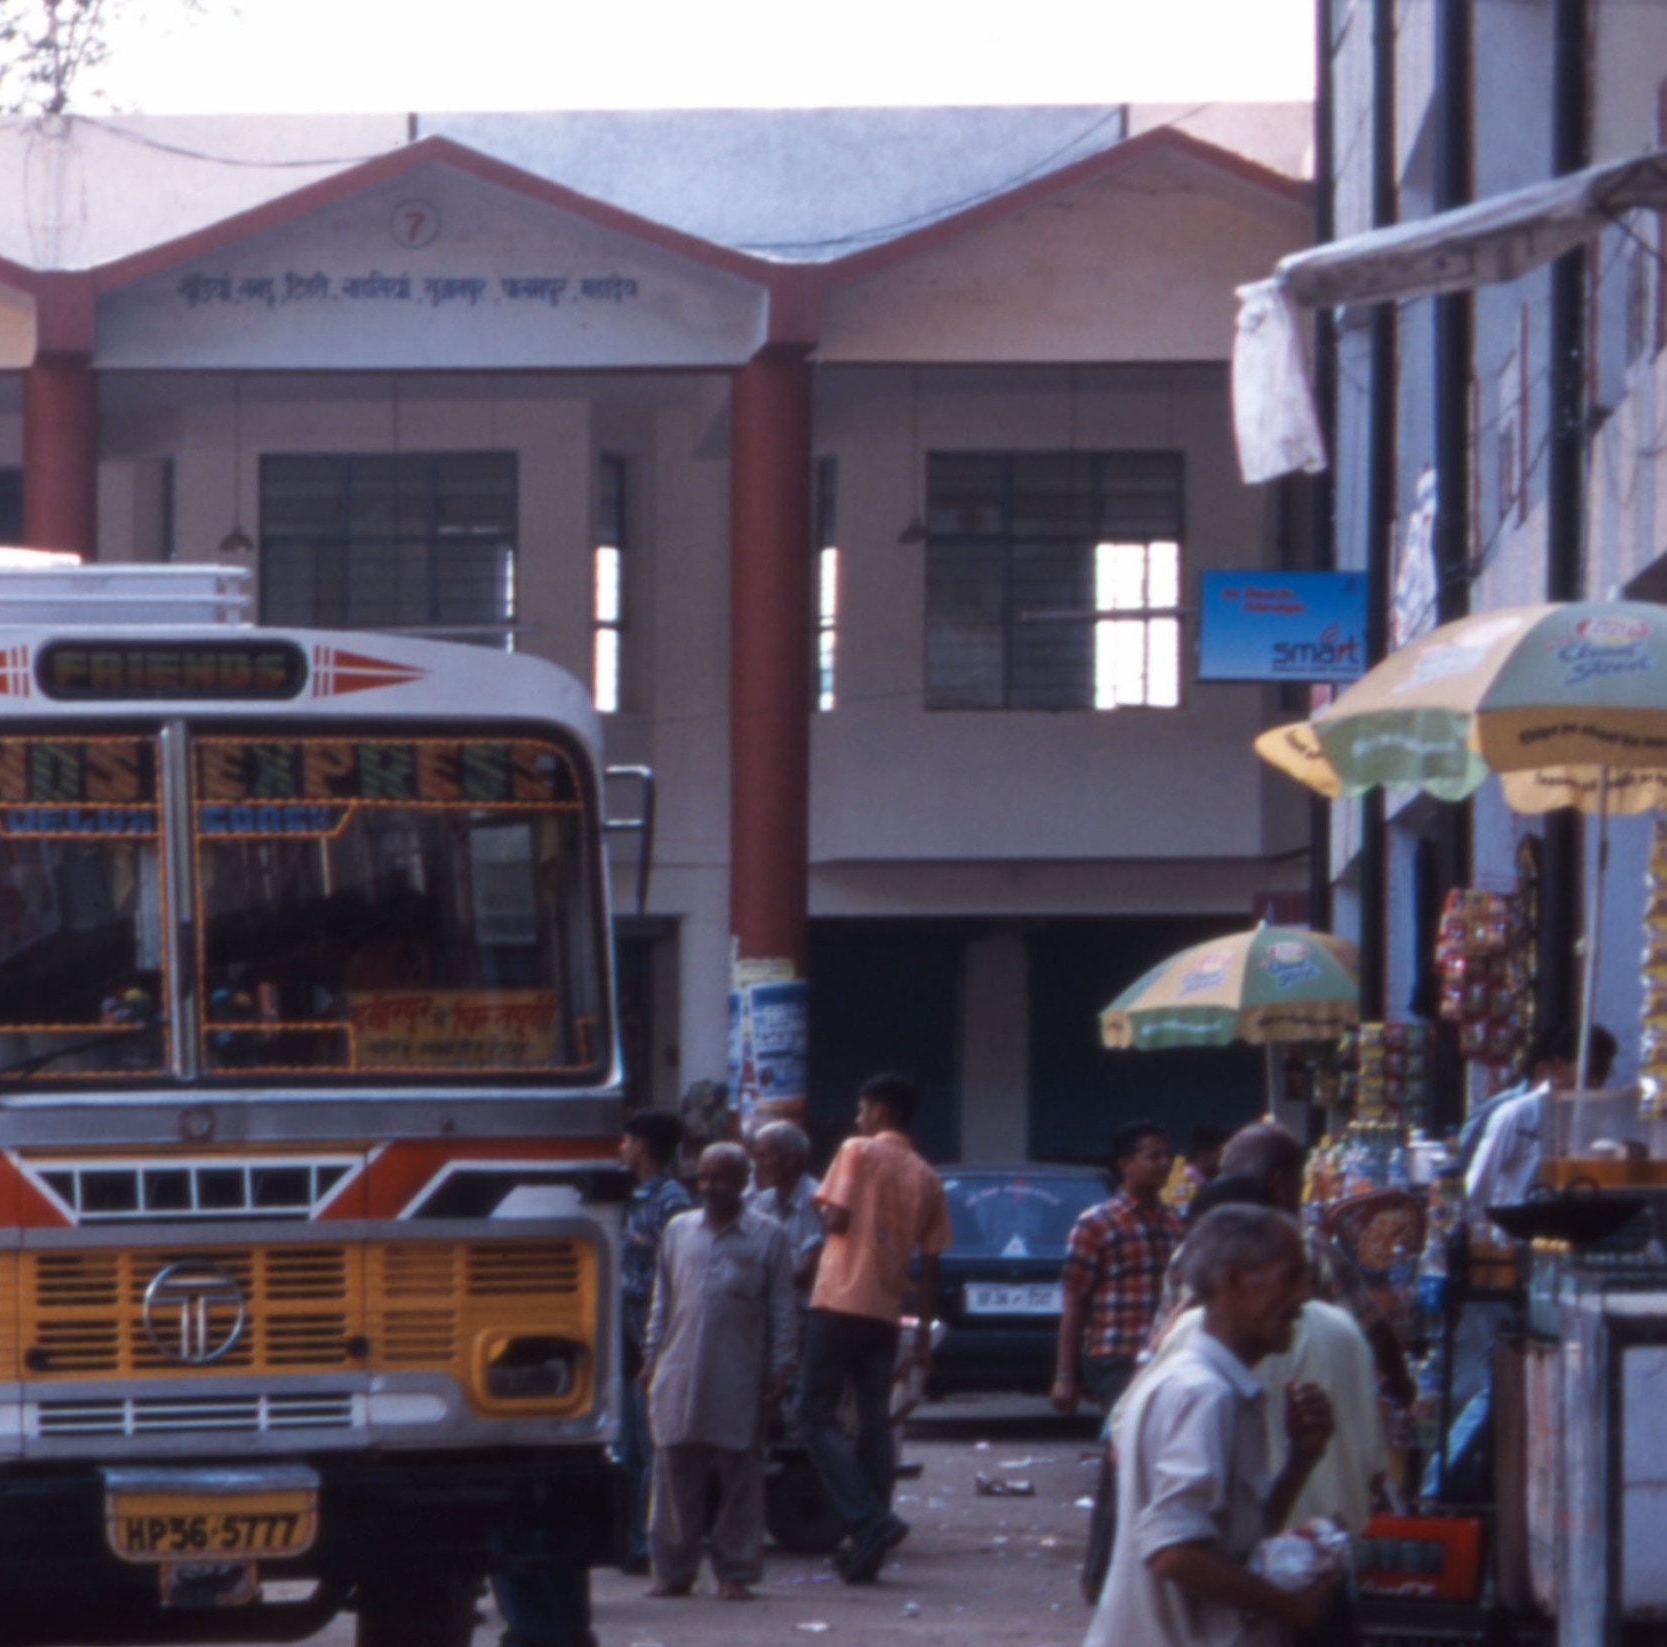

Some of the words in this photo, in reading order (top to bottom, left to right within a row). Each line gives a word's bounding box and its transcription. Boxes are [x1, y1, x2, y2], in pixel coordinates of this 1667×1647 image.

[405, 212, 426, 243] 7
[1272, 633, 1361, 665] smart
[53, 651, 286, 692] FRIENDS
[201, 740, 557, 800] EXPRESS
